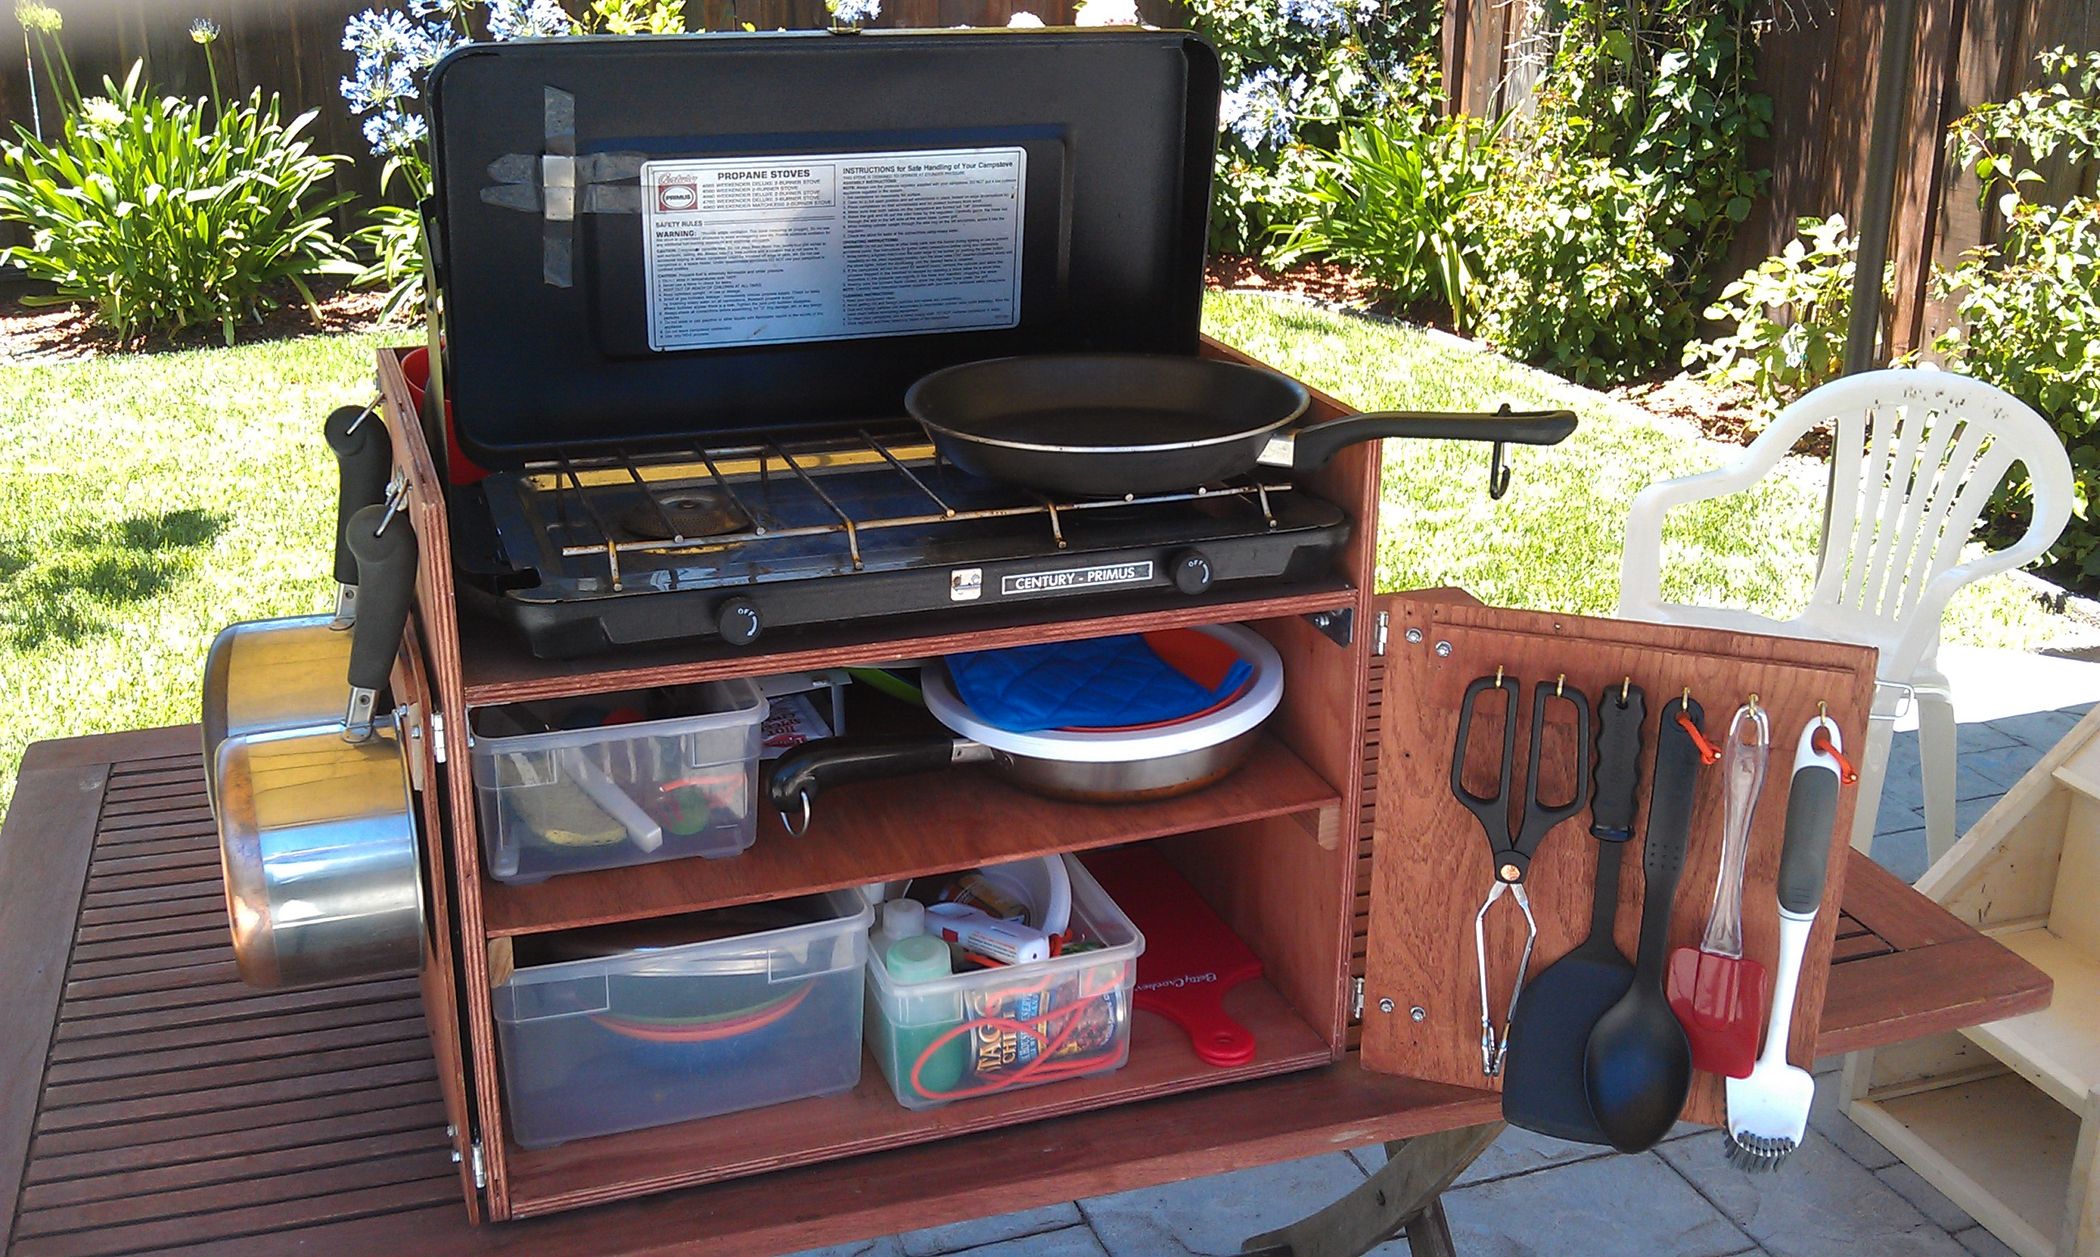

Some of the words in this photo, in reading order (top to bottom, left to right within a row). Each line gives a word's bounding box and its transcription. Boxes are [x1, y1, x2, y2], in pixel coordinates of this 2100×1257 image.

[843, 166, 895, 174] INSTRUCTIONS
[924, 164, 952, 173] Handling
[978, 161, 1013, 170] Campstove
[718, 171, 767, 180] PROPANE
[771, 169, 810, 178] STOVES
[656, 230, 697, 238] WARNING:
[1188, 559, 1203, 568] OFF
[1015, 573, 1075, 590] CENTURY
[1087, 567, 1136, 583] PRIMUS
[737, 607, 755, 617] OFF
[1185, 972, 1217, 984] Betty
